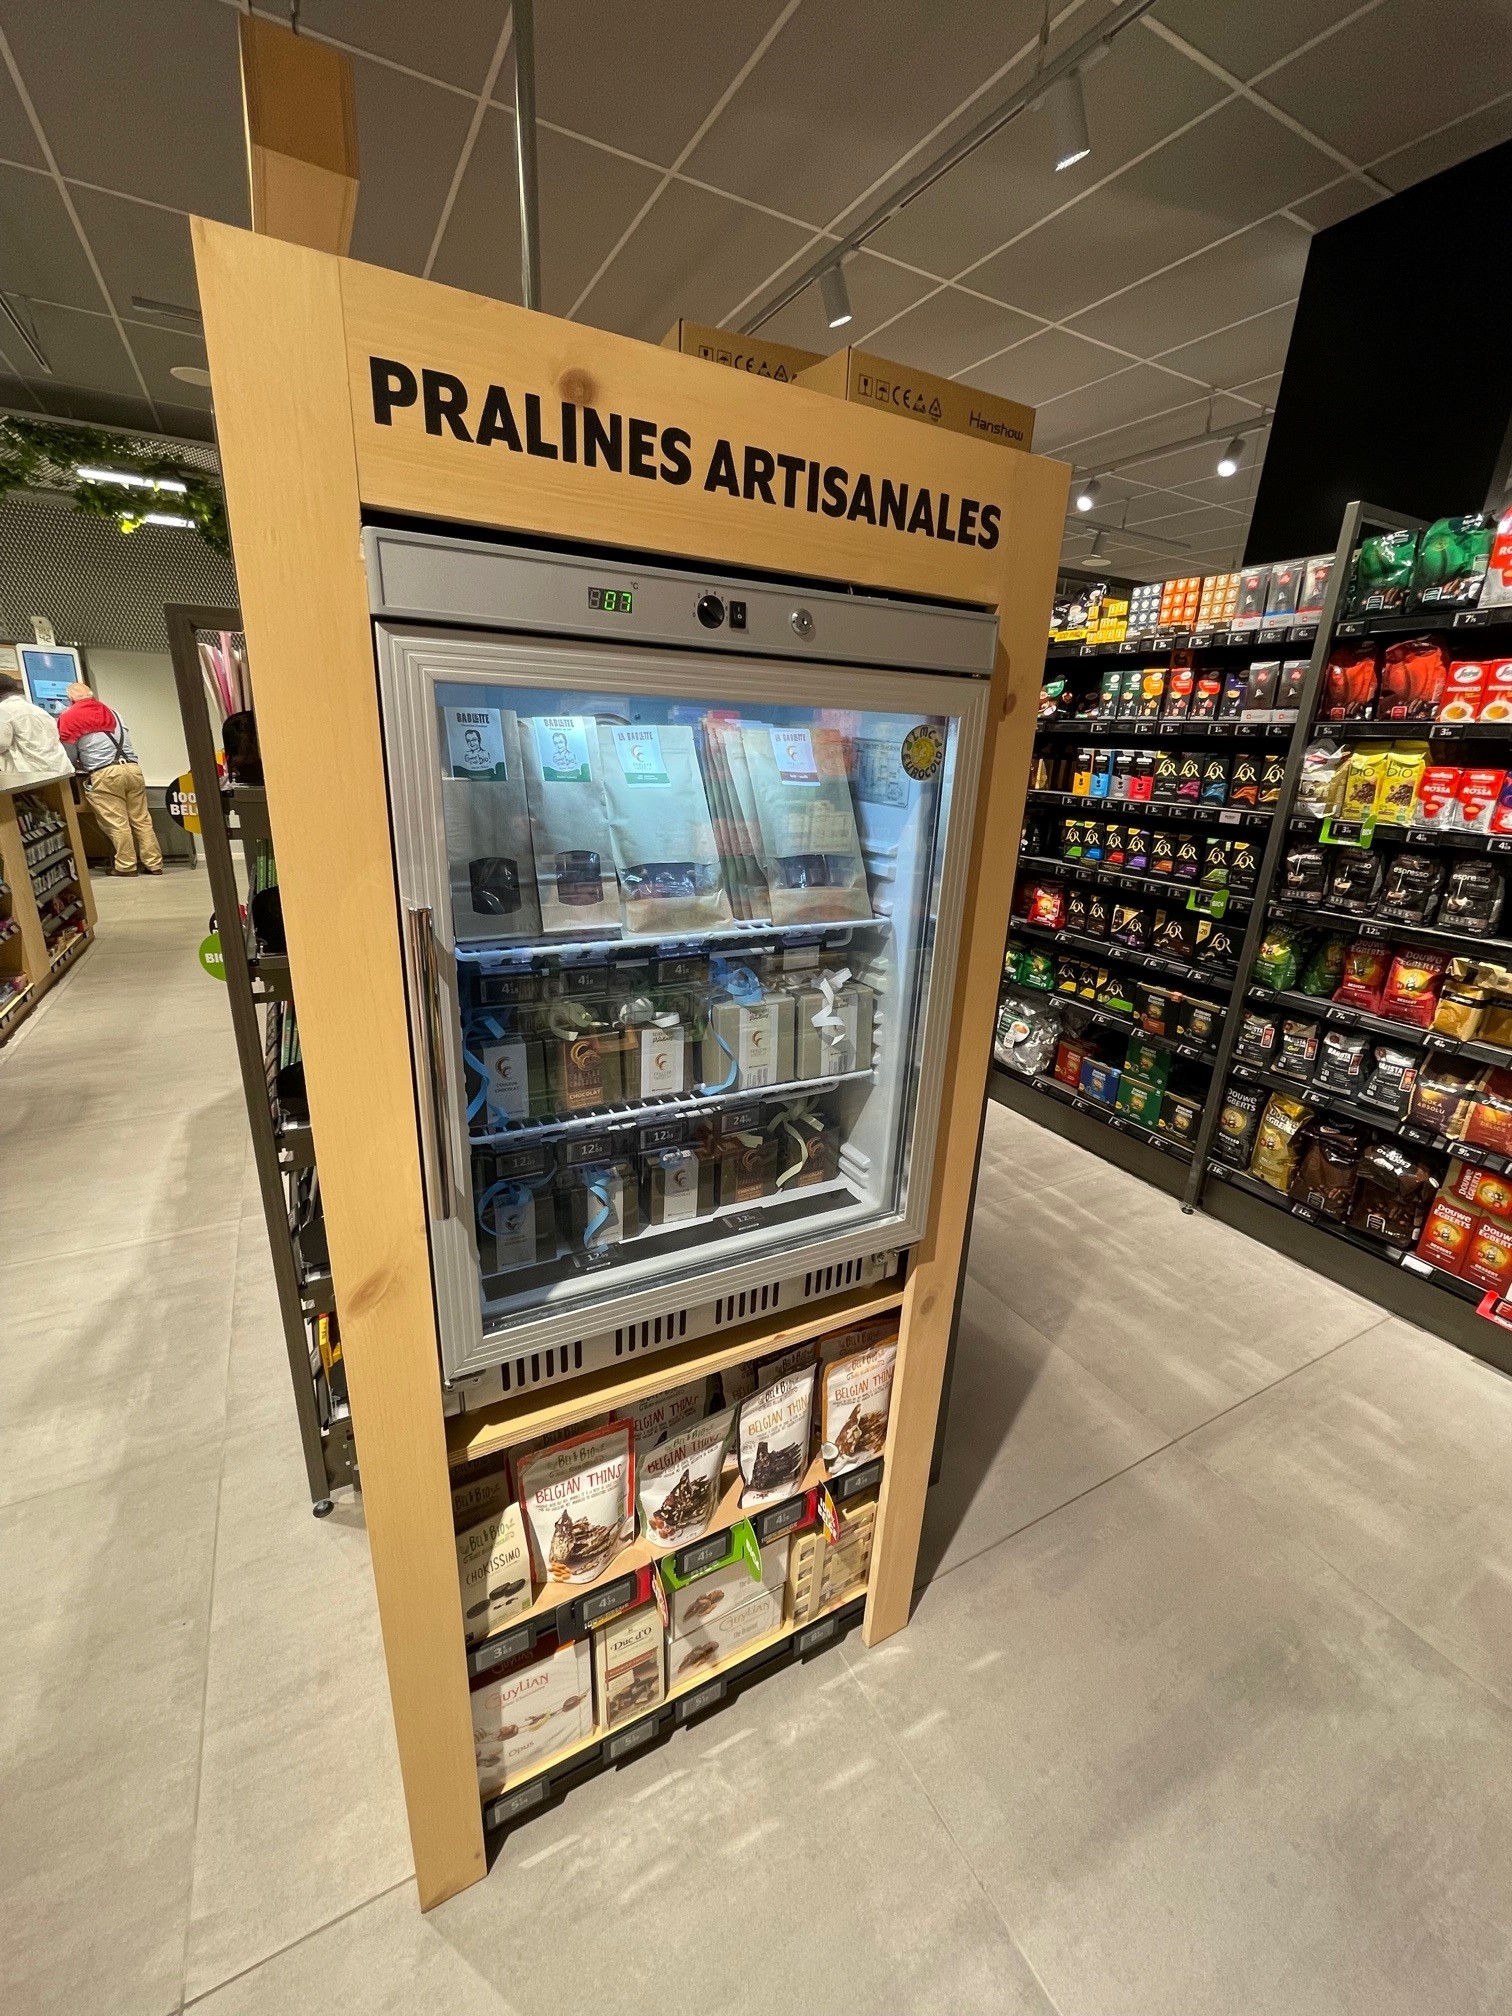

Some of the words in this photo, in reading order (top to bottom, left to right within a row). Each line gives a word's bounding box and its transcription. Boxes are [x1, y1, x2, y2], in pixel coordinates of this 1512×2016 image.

[969, 411, 1025, 441] Hanshow
[370, 356, 692, 485] PRALINES
[704, 439, 1001, 550] ARTISANALES
[1156, 758, 1178, 777] L'OR
[1179, 759, 1201, 778] L'OR
[1203, 761, 1226, 780] L'OR
[1232, 762, 1258, 782] L'OR
[1350, 763, 1376, 777] bio
[1386, 761, 1414, 778] bio
[1423, 785, 1451, 794] ROSSA
[1463, 786, 1493, 796] ROSSA
[170, 803, 199, 816] BEL
[1394, 866, 1430, 878] espresso
[1453, 873, 1491, 884] espresso
[1207, 932, 1233, 954] L'OR
[1351, 944, 1386, 957] EGBERTS
[569, 1090, 601, 1100] CHOCOLAT
[1226, 1097, 1256, 1112] GBERTS
[1417, 1102, 1446, 1115] ABSOLU
[1465, 1171, 1483, 1201] EGBERTS
[1434, 1209, 1472, 1230] EGBERTS
[1479, 1228, 1512, 1249] EGBERT
[835, 1379, 869, 1401] BELGIAN
[635, 1406, 665, 1431] ELGIAN
[669, 1395, 699, 1417] THINS
[748, 1408, 784, 1436] BELGIAN
[647, 1444, 686, 1474] BELGIAN
[692, 1433, 720, 1453] THINS
[535, 1476, 581, 1504] BELGIAN
[587, 1463, 623, 1487] THINS
[466, 1546, 521, 1586] CHOKISSIMO
[610, 1636, 634, 1651] Duc
[635, 1627, 652, 1640] d'O
[508, 1740, 535, 1758] Opus
